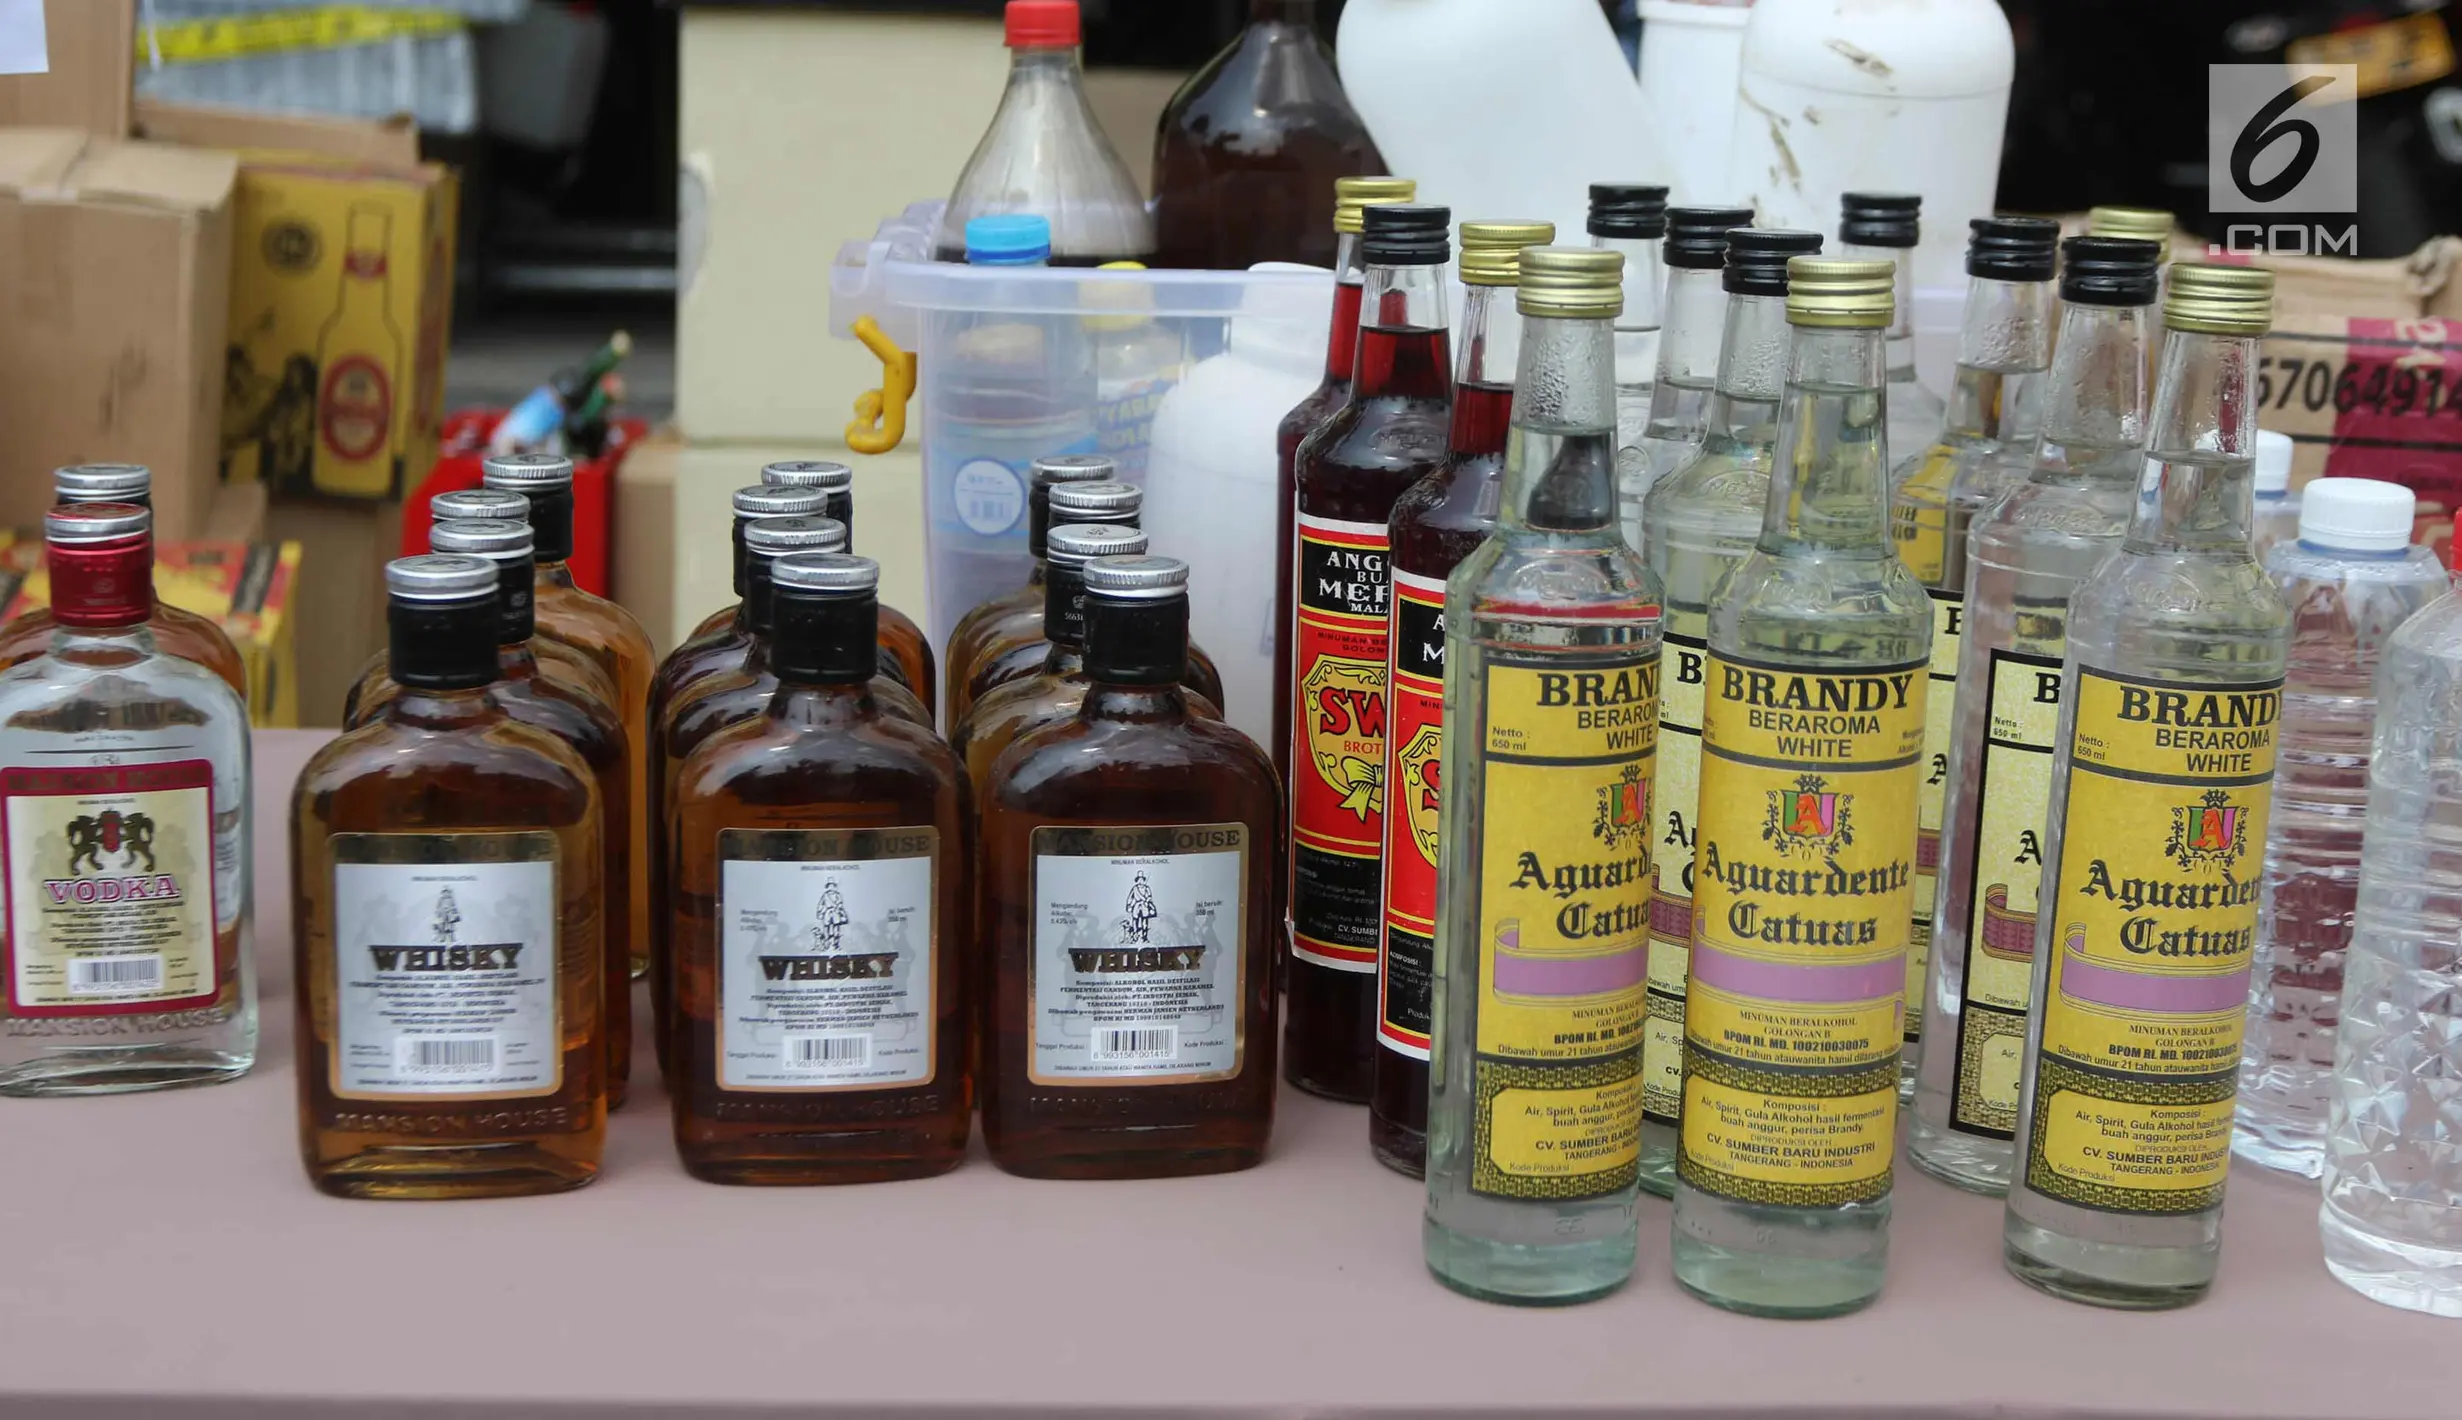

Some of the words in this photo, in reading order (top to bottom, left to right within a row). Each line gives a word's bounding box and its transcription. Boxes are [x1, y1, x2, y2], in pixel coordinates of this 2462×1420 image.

[1327, 551, 1389, 571] ANG
[1357, 571, 1388, 584] BU
[1721, 664, 1914, 713] BRANDY
[2117, 685, 2282, 728] BRAND
[1749, 708, 1881, 736] BERAROMA
[1995, 716, 2018, 728] Netto
[1492, 739, 1510, 750] 650
[1513, 741, 1527, 751] ml
[1606, 724, 1654, 750] WHITE
[2078, 733, 2104, 748] Netto
[2155, 728, 2270, 750] BERAROMA
[1343, 740, 1383, 755] BROT
[1776, 735, 1853, 758] WHITE
[2093, 749, 2106, 760] ml
[2186, 753, 2253, 773] WHITE
[1702, 841, 1910, 897] Aguardente
[44, 873, 181, 905] VODKA
[1728, 900, 1878, 947] Catuas
[368, 942, 524, 972] WHISKY
[1068, 945, 1206, 973] WHISKY
[758, 952, 899, 981] WHISKY
[1572, 1006, 1615, 1020] MINUMAN
[1739, 1010, 1787, 1026] MINUMAN
[1789, 1016, 1858, 1027] BERALKOHOL
[1723, 1029, 1752, 1046] BPOM
[1764, 1027, 1822, 1039] GOLONGAN
[1823, 1030, 1831, 1039] B
[2128, 1025, 2178, 1036] MINUMAN
[1554, 1033, 1584, 1045] BPOM
[2155, 1038, 2208, 1048] GOLONGAN
[1498, 1043, 1538, 1056] Dibawah
[1567, 1047, 1577, 1057] 21
[1580, 1045, 1603, 1055] tahun
[1734, 1045, 1744, 1057] 21
[1746, 1048, 1772, 1061] tahun
[1828, 1053, 1852, 1065] hamil
[2058, 1044, 2092, 1062] Dibawah
[2094, 1056, 2119, 1068] umur
[2121, 1059, 2131, 1070] 21
[2135, 1061, 2162, 1072] tahun
[2109, 1044, 2141, 1059] BPOM
[1579, 1103, 1601, 1113] Gula
[1763, 1099, 1820, 1113] Komposisi
[1553, 1116, 1579, 1127] buah
[1744, 1108, 1769, 1121] Gula
[1772, 1109, 1813, 1124] Alkohol
[1816, 1110, 1840, 1123] hasil
[2150, 1109, 2201, 1121] Komposisi
[1720, 1115, 1745, 1128] buah
[1791, 1123, 1826, 1138] perisa
[1828, 1121, 1864, 1136] Brandy
[2130, 1119, 2155, 1130] Gula
[2157, 1119, 2195, 1131] Alkohol
[2101, 1127, 2129, 1140] buah
[1559, 1136, 1608, 1150] SUMBER
[1726, 1138, 1779, 1157] SUMBER
[1783, 1148, 1821, 1158] BARU
[1824, 1141, 1876, 1157] INDUSTRI
[1564, 1144, 1618, 1160] TANGERANG
[1730, 1151, 1792, 1168] TANGERANG
[1800, 1157, 1854, 1169] INDONESIA
[2082, 1146, 2102, 1159] CV.
[2106, 1151, 2163, 1164] SUMBER
[2166, 1153, 2199, 1165] BARU
[2110, 1163, 2174, 1175] TANGERANG
